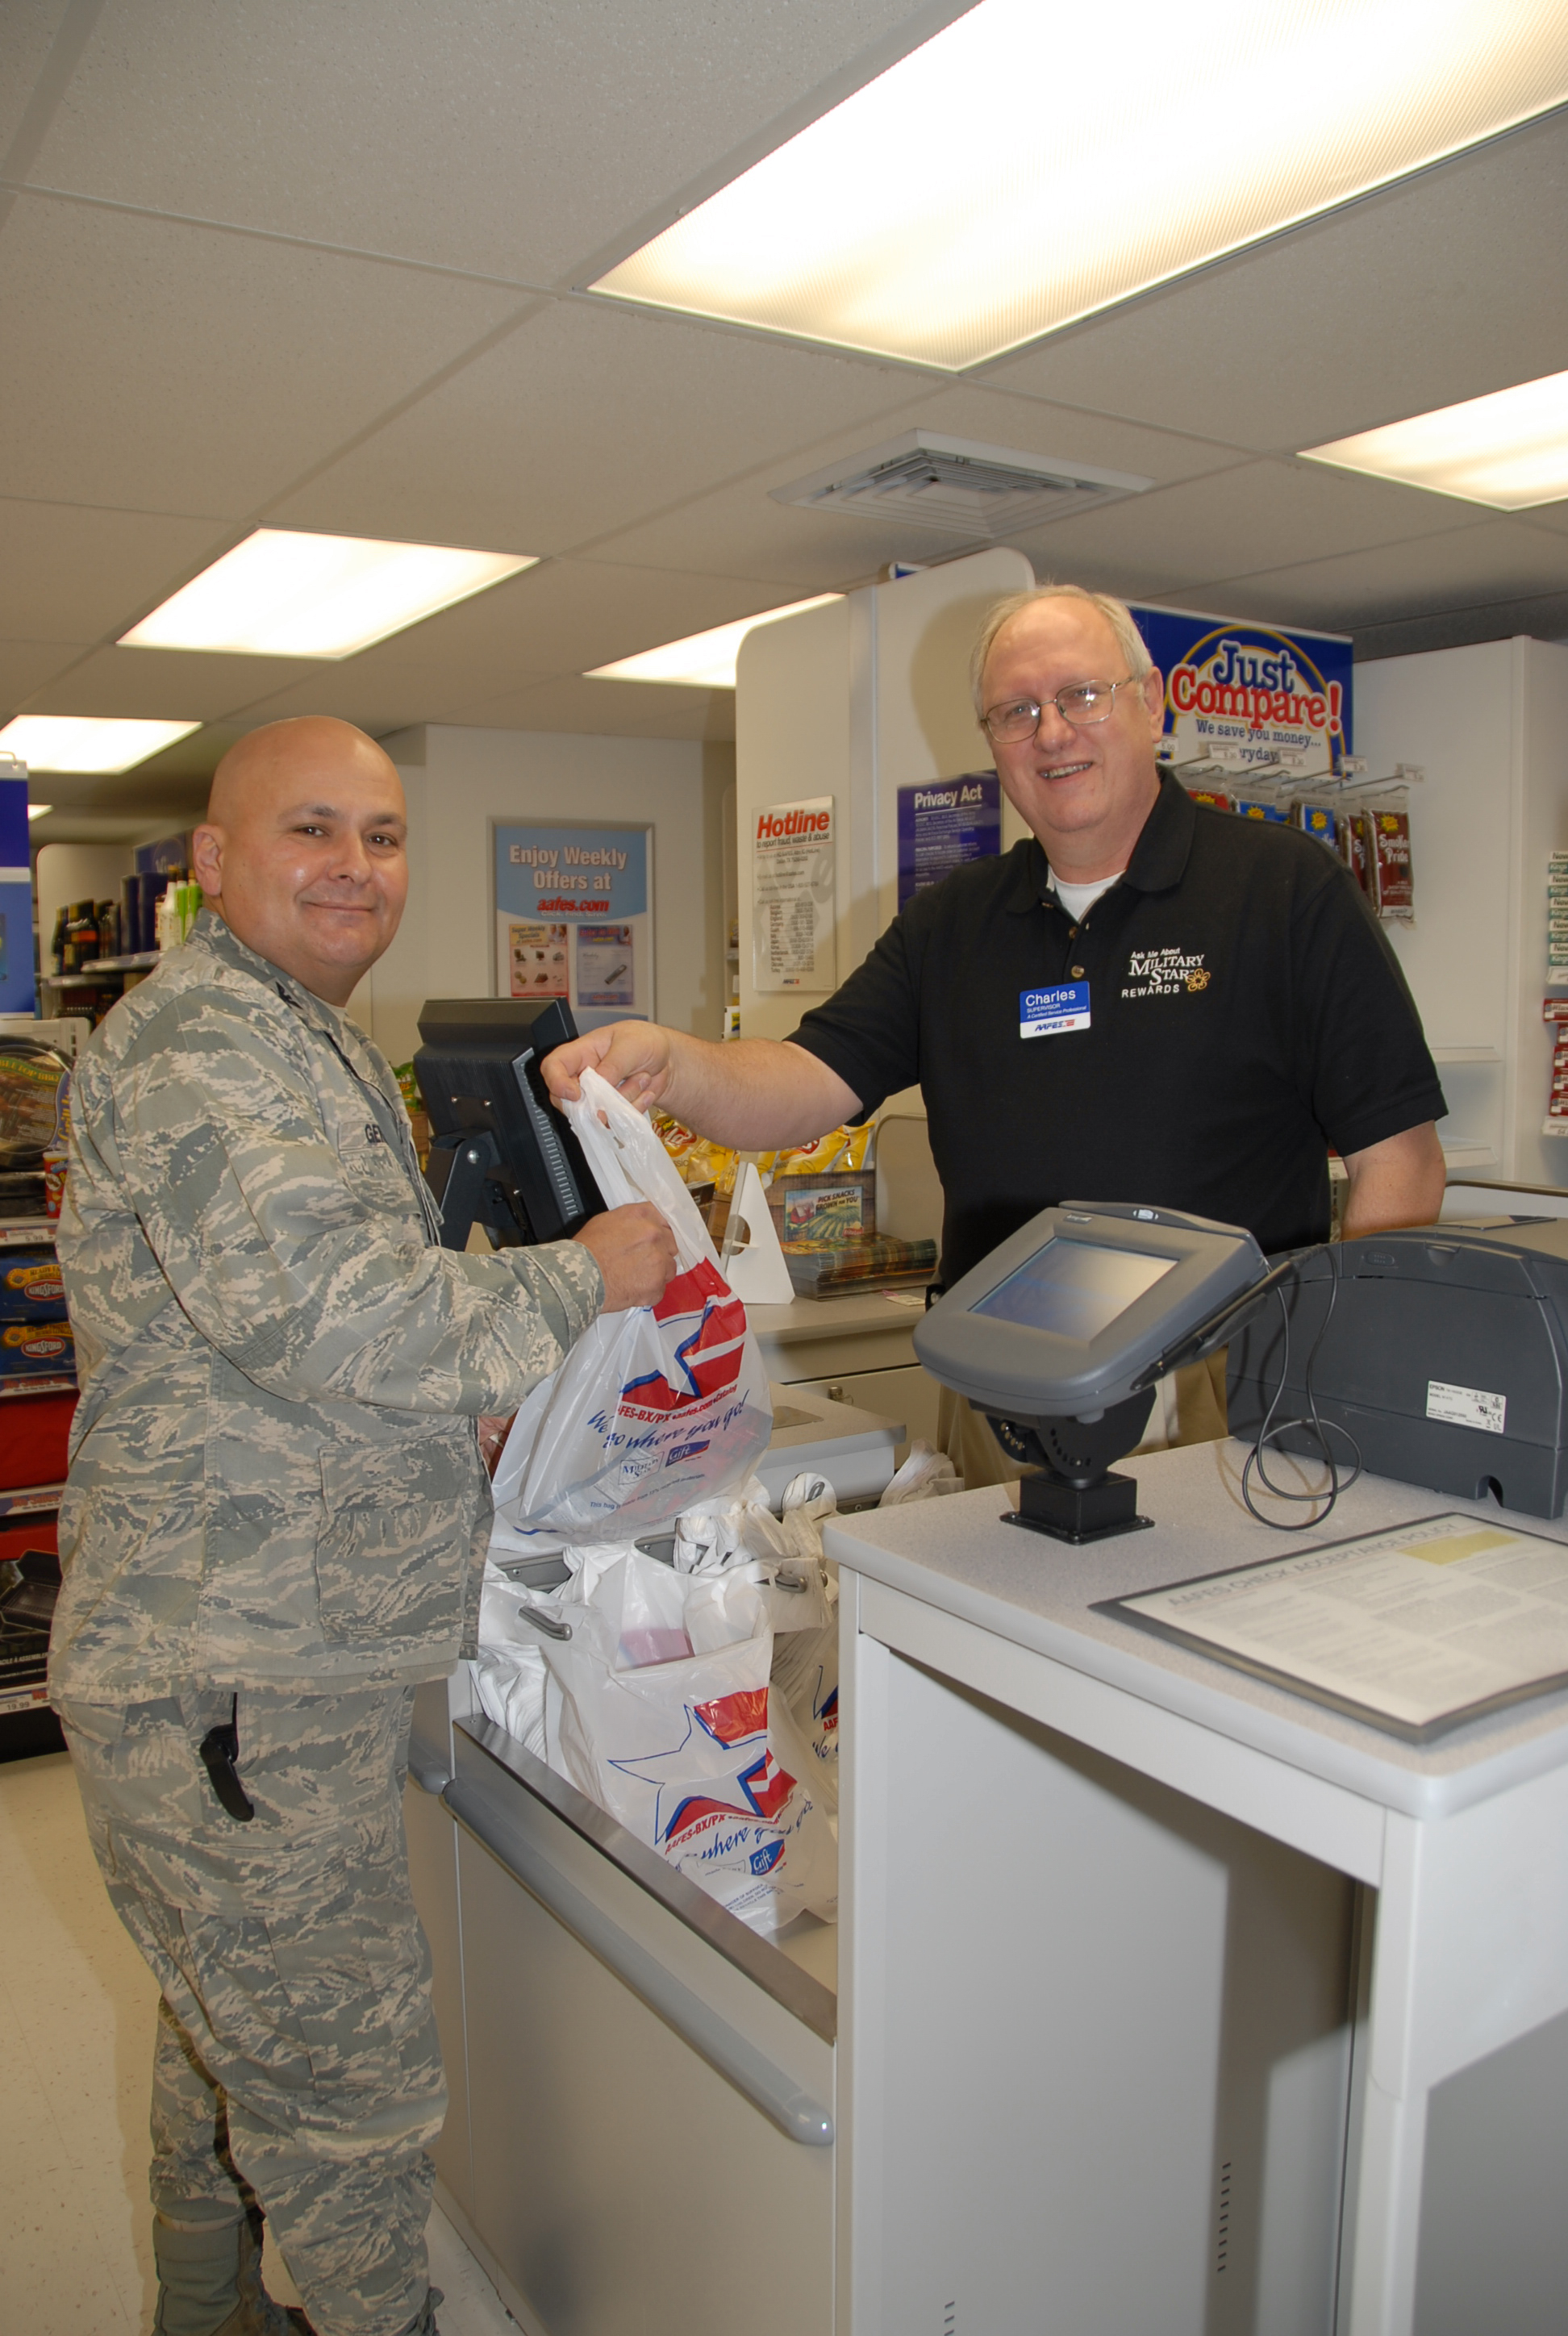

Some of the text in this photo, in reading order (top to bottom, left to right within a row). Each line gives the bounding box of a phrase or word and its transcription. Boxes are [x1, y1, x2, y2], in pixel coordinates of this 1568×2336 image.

[1213, 643, 1295, 694] Just
[1173, 666, 1341, 732] Compare!
[1196, 719, 1321, 747] We save you money...
[1240, 747, 1278, 762] ryday
[915, 783, 982, 809] Privacy Act
[757, 810, 830, 840] Hotline
[757, 841, 761, 849] to
[762, 839, 777, 849] report
[792, 836, 807, 844] waste
[807, 833, 812, 842] &
[813, 832, 830, 841] abuse
[509, 845, 628, 870] Enjoy Weekly
[533, 870, 612, 891] Offers at
[537, 896, 610, 912] aafes.com
[1131, 947, 1181, 959] Ask Me About
[1128, 954, 1205, 976] MILITARY
[1149, 967, 1190, 986] STAR
[1025, 990, 1076, 1007] Charles
[1121, 983, 1180, 998] REWARDS
[1027, 1003, 1061, 1013] SUPERVISOR
[1062, 1005, 1087, 1013] Professional
[1035, 1020, 1064, 1032] AAFES
[816, 1200, 838, 1211] GROWN
[846, 1195, 859, 1204] YOU
[818, 1189, 855, 1203] PICK SNACKS
[25, 1340, 62, 1354] KINGSFORD
[1429, 1383, 1445, 1392] EPSON
[626, 1428, 684, 1449] where
[685, 1416, 722, 1441] you
[669, 1446, 691, 1462] Gift
[603, 1501, 615, 1510] bag
[1230, 1567, 1288, 1589] CHECK
[1294, 1538, 1401, 1573] ACCEPTANCE
[1401, 1522, 1458, 1544] POLICY
[6, 1701, 30, 1711] 19.99
[665, 1813, 727, 1855] AAFES-BX/PX
[701, 1826, 753, 1860] where
[753, 1849, 774, 1871] Gift
